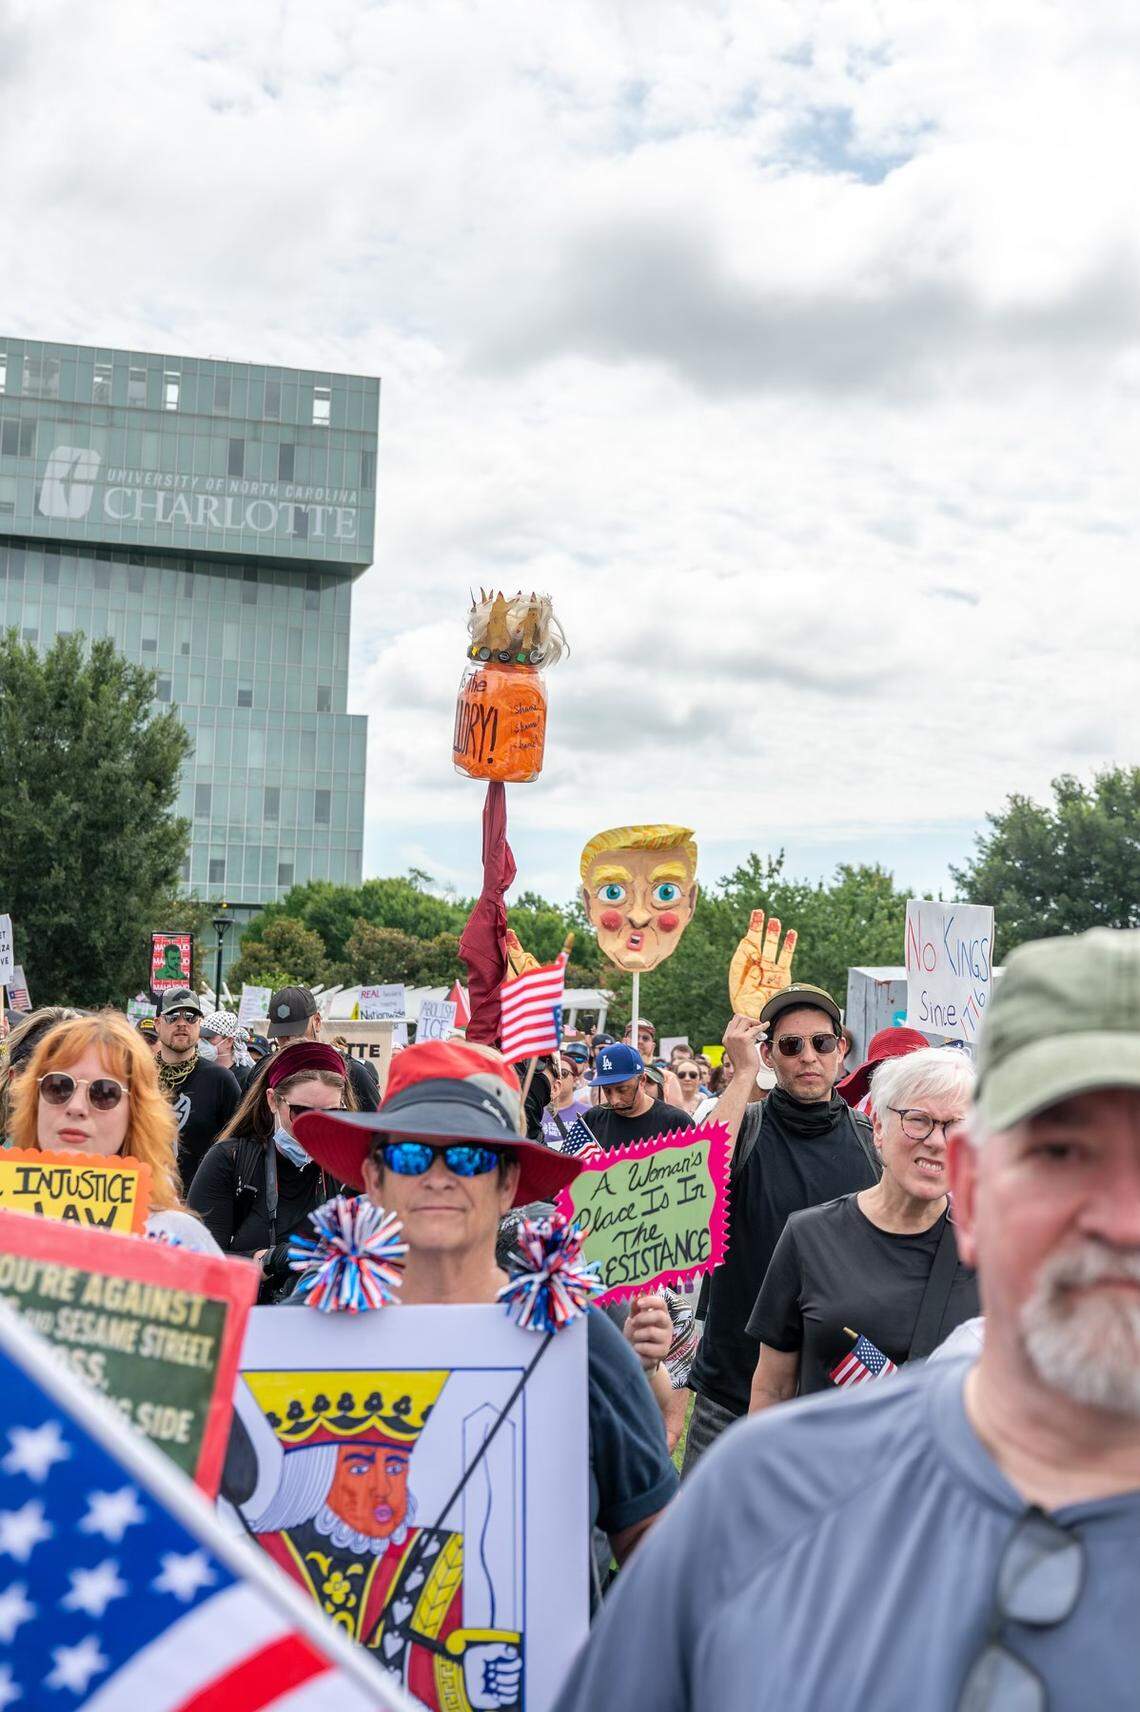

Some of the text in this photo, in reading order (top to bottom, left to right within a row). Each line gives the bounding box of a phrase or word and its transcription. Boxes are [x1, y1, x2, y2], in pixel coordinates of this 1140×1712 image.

[107, 468, 358, 504] UNIVERSITY OF NORTH CAROLINA
[103, 486, 357, 538] CHARLOTTE
[361, 990, 380, 1000] REAL
[959, 987, 987, 1041] 1776
[421, 1017, 449, 1039] ICE
[602, 1055, 613, 1071] LA
[13, 1167, 135, 1204] INJUSTICE
[591, 1151, 702, 1200] A Woman's
[572, 1174, 707, 1237] Place Is In
[595, 1228, 710, 1287] ESISTANCE
[612, 1222, 664, 1252] The
[81, 1272, 207, 1328] AGAINST
[54, 1306, 142, 1355] SESAME
[136, 1402, 195, 1444] SIDE
